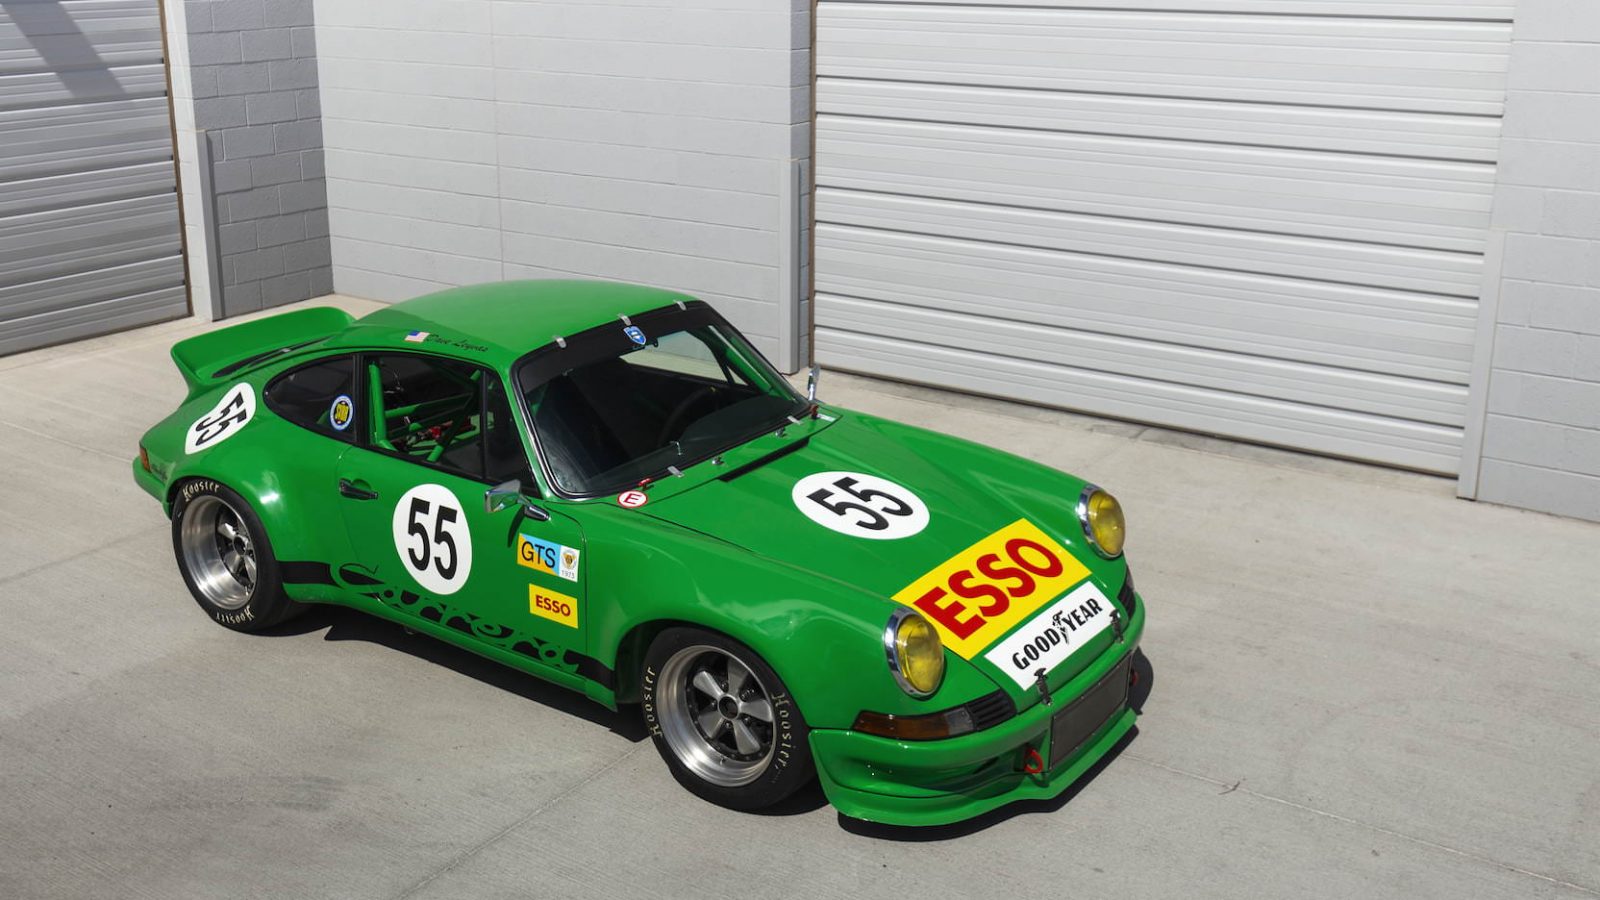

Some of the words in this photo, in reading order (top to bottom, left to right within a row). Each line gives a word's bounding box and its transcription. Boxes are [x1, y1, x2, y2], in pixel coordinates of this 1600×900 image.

[195, 392, 247, 446] 55
[182, 481, 219, 502] Hoosier
[623, 492, 643, 505] E
[805, 475, 914, 531] 55
[407, 496, 458, 580] 55
[521, 540, 556, 569] GTS
[216, 604, 255, 624] Hoosier
[535, 594, 571, 617] ESSO
[912, 537, 1064, 641] ESSO
[644, 666, 663, 737] Hoosier
[771, 692, 792, 767] Hoosier
